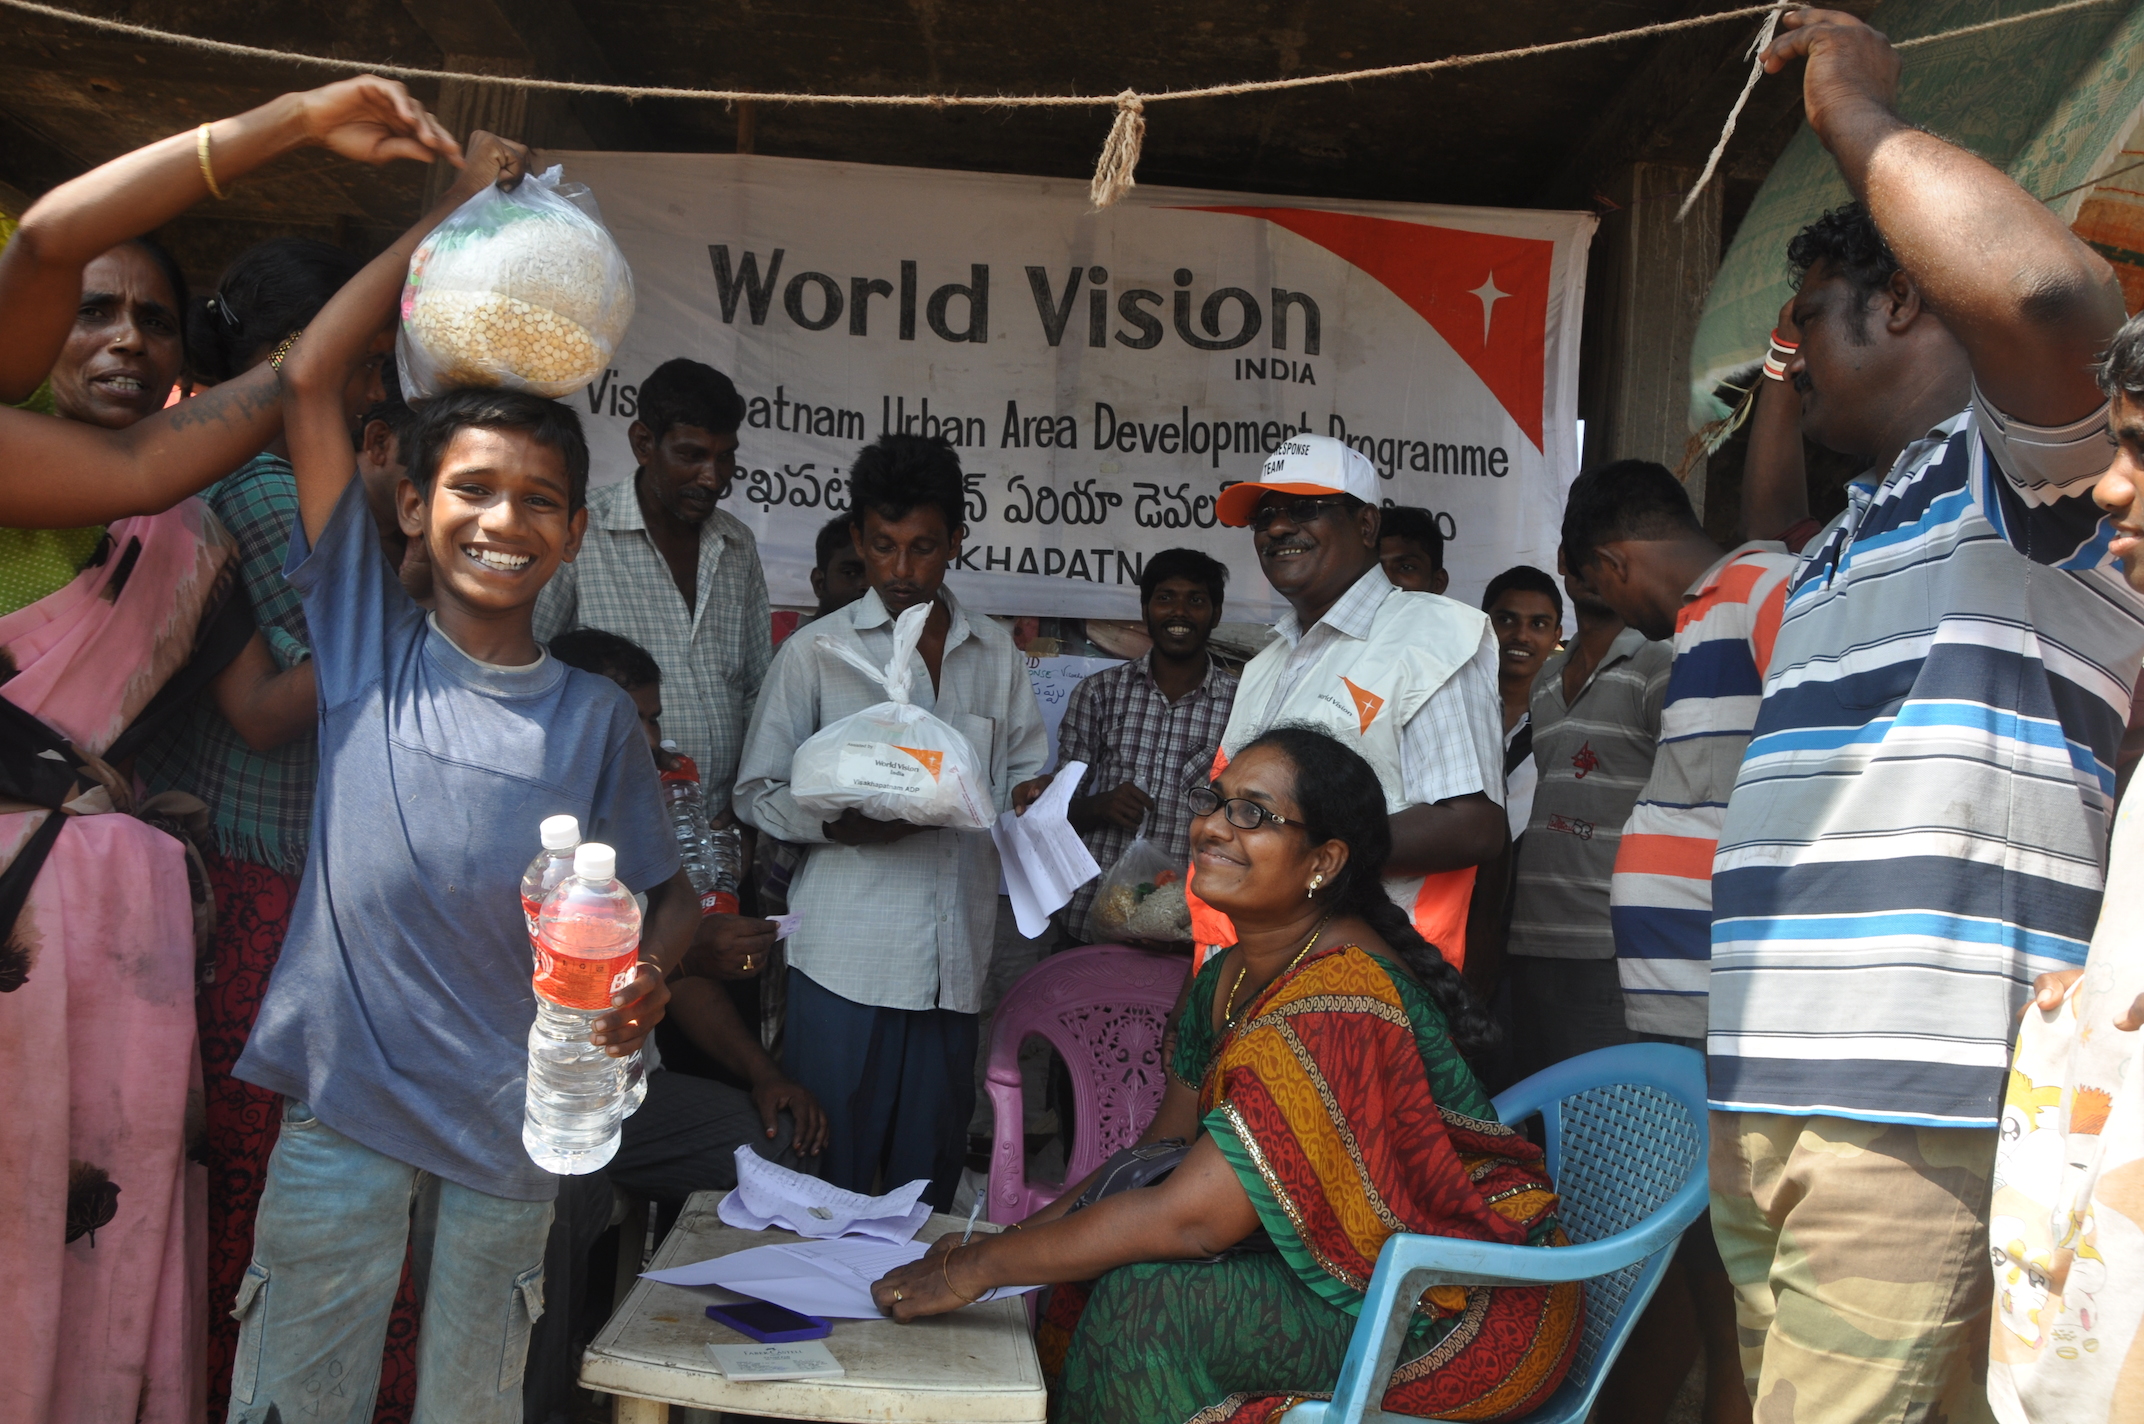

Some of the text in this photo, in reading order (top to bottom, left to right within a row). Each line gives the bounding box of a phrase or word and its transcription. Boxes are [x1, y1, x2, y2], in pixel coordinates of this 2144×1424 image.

[708, 244, 1321, 356] World Vision
[1235, 357, 1316, 386] INDIA
[883, 395, 986, 448] Urban
[1000, 399, 1078, 450] Area
[1263, 459, 1285, 477] TEAM
[1003, 474, 1123, 526] ఏరియా
[1332, 698, 1353, 717] Vision
[874, 759, 920, 773] World Vision
[889, 769, 905, 777] India
[853, 778, 921, 794] Visakhapatnam ADP
